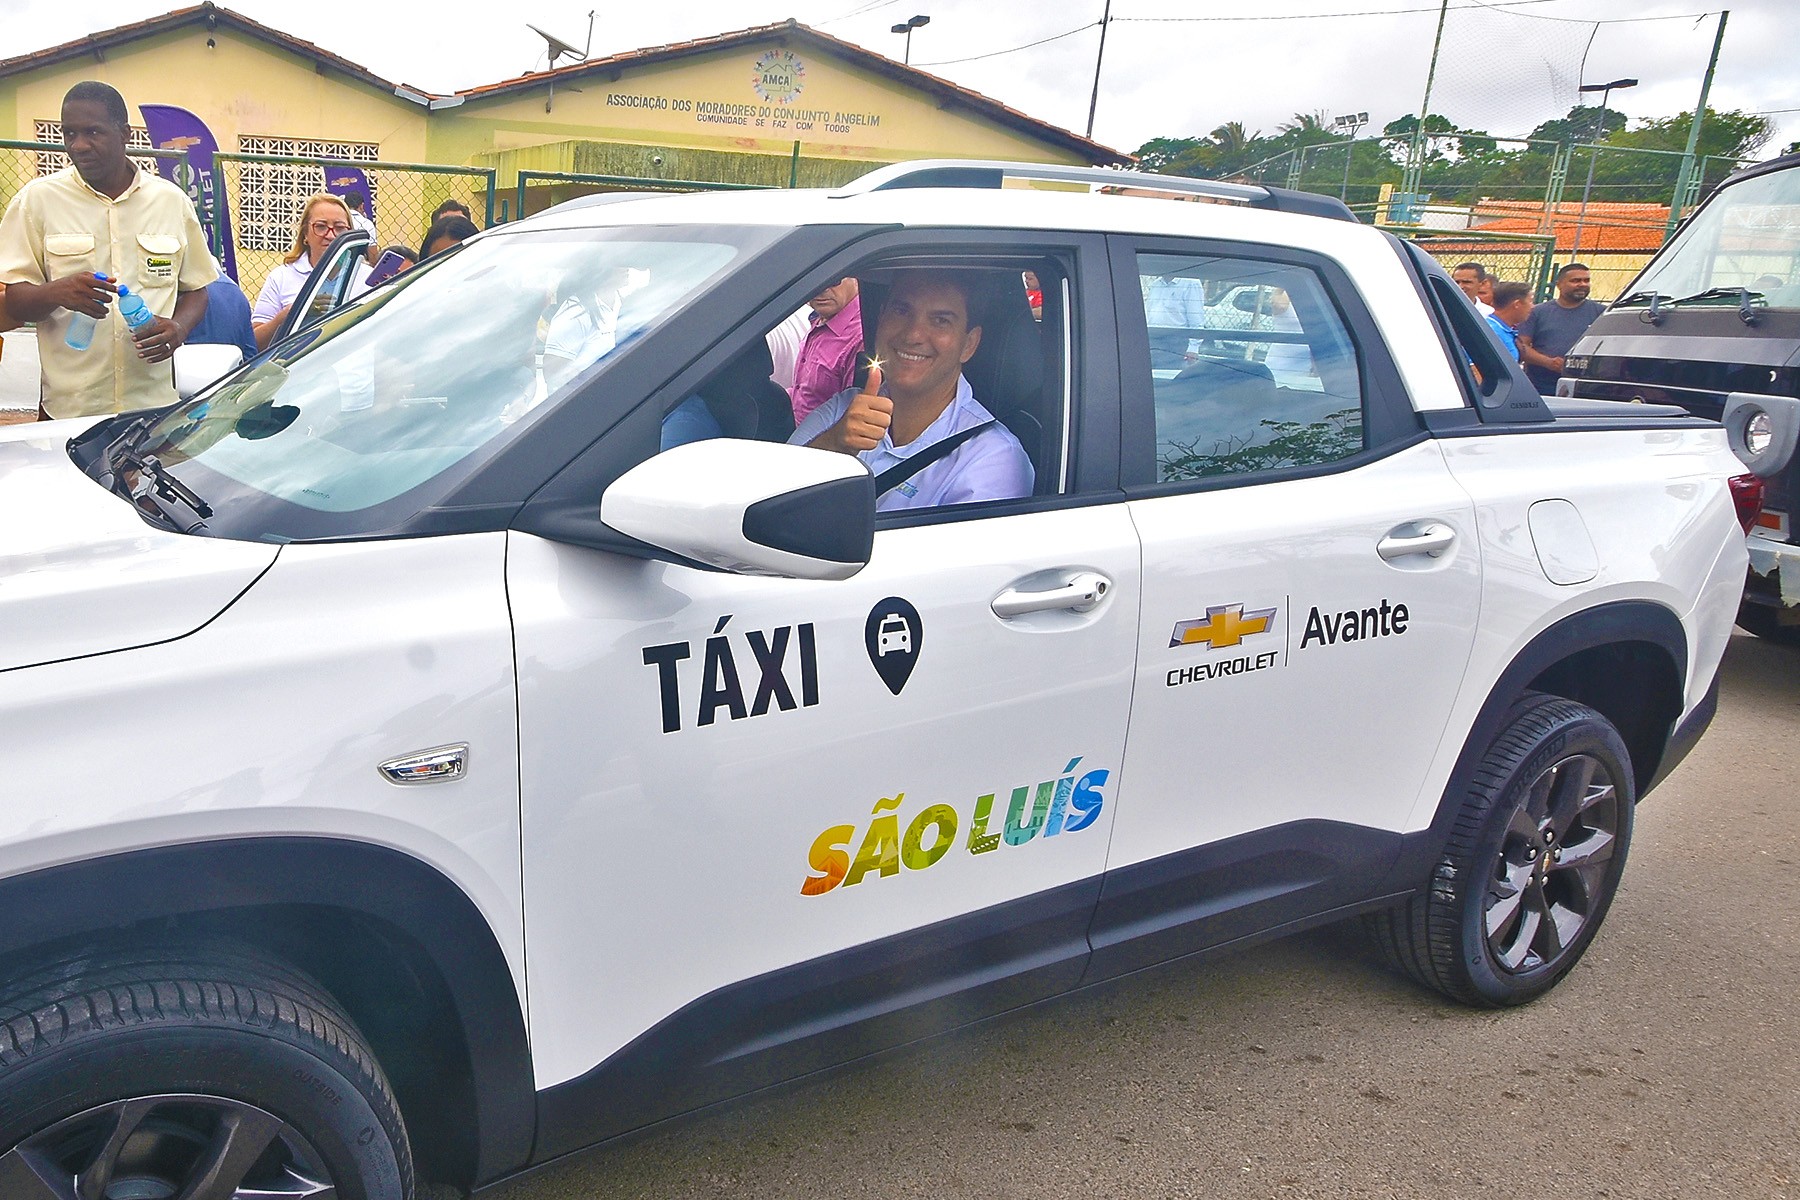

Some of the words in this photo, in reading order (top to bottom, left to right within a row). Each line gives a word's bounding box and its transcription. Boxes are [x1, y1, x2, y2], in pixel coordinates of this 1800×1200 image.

[762, 74, 790, 86] AMCA
[672, 99, 692, 112] DOS
[696, 102, 757, 117] MORADORES
[759, 106, 771, 118] DO
[773, 108, 830, 122] CONJUNTO
[697, 113, 747, 126] COMUNIDADE
[755, 118, 765, 127] SE
[772, 120, 787, 129] FAZ
[796, 121, 813, 131] COM
[825, 123, 851, 134] TODOS
[1300, 599, 1409, 649] Avante
[642, 614, 820, 734] TÁXI
[1166, 651, 1278, 687] CHEVROLET
[800, 792, 958, 896] SÃO
[965, 755, 1110, 856] LUÍS
